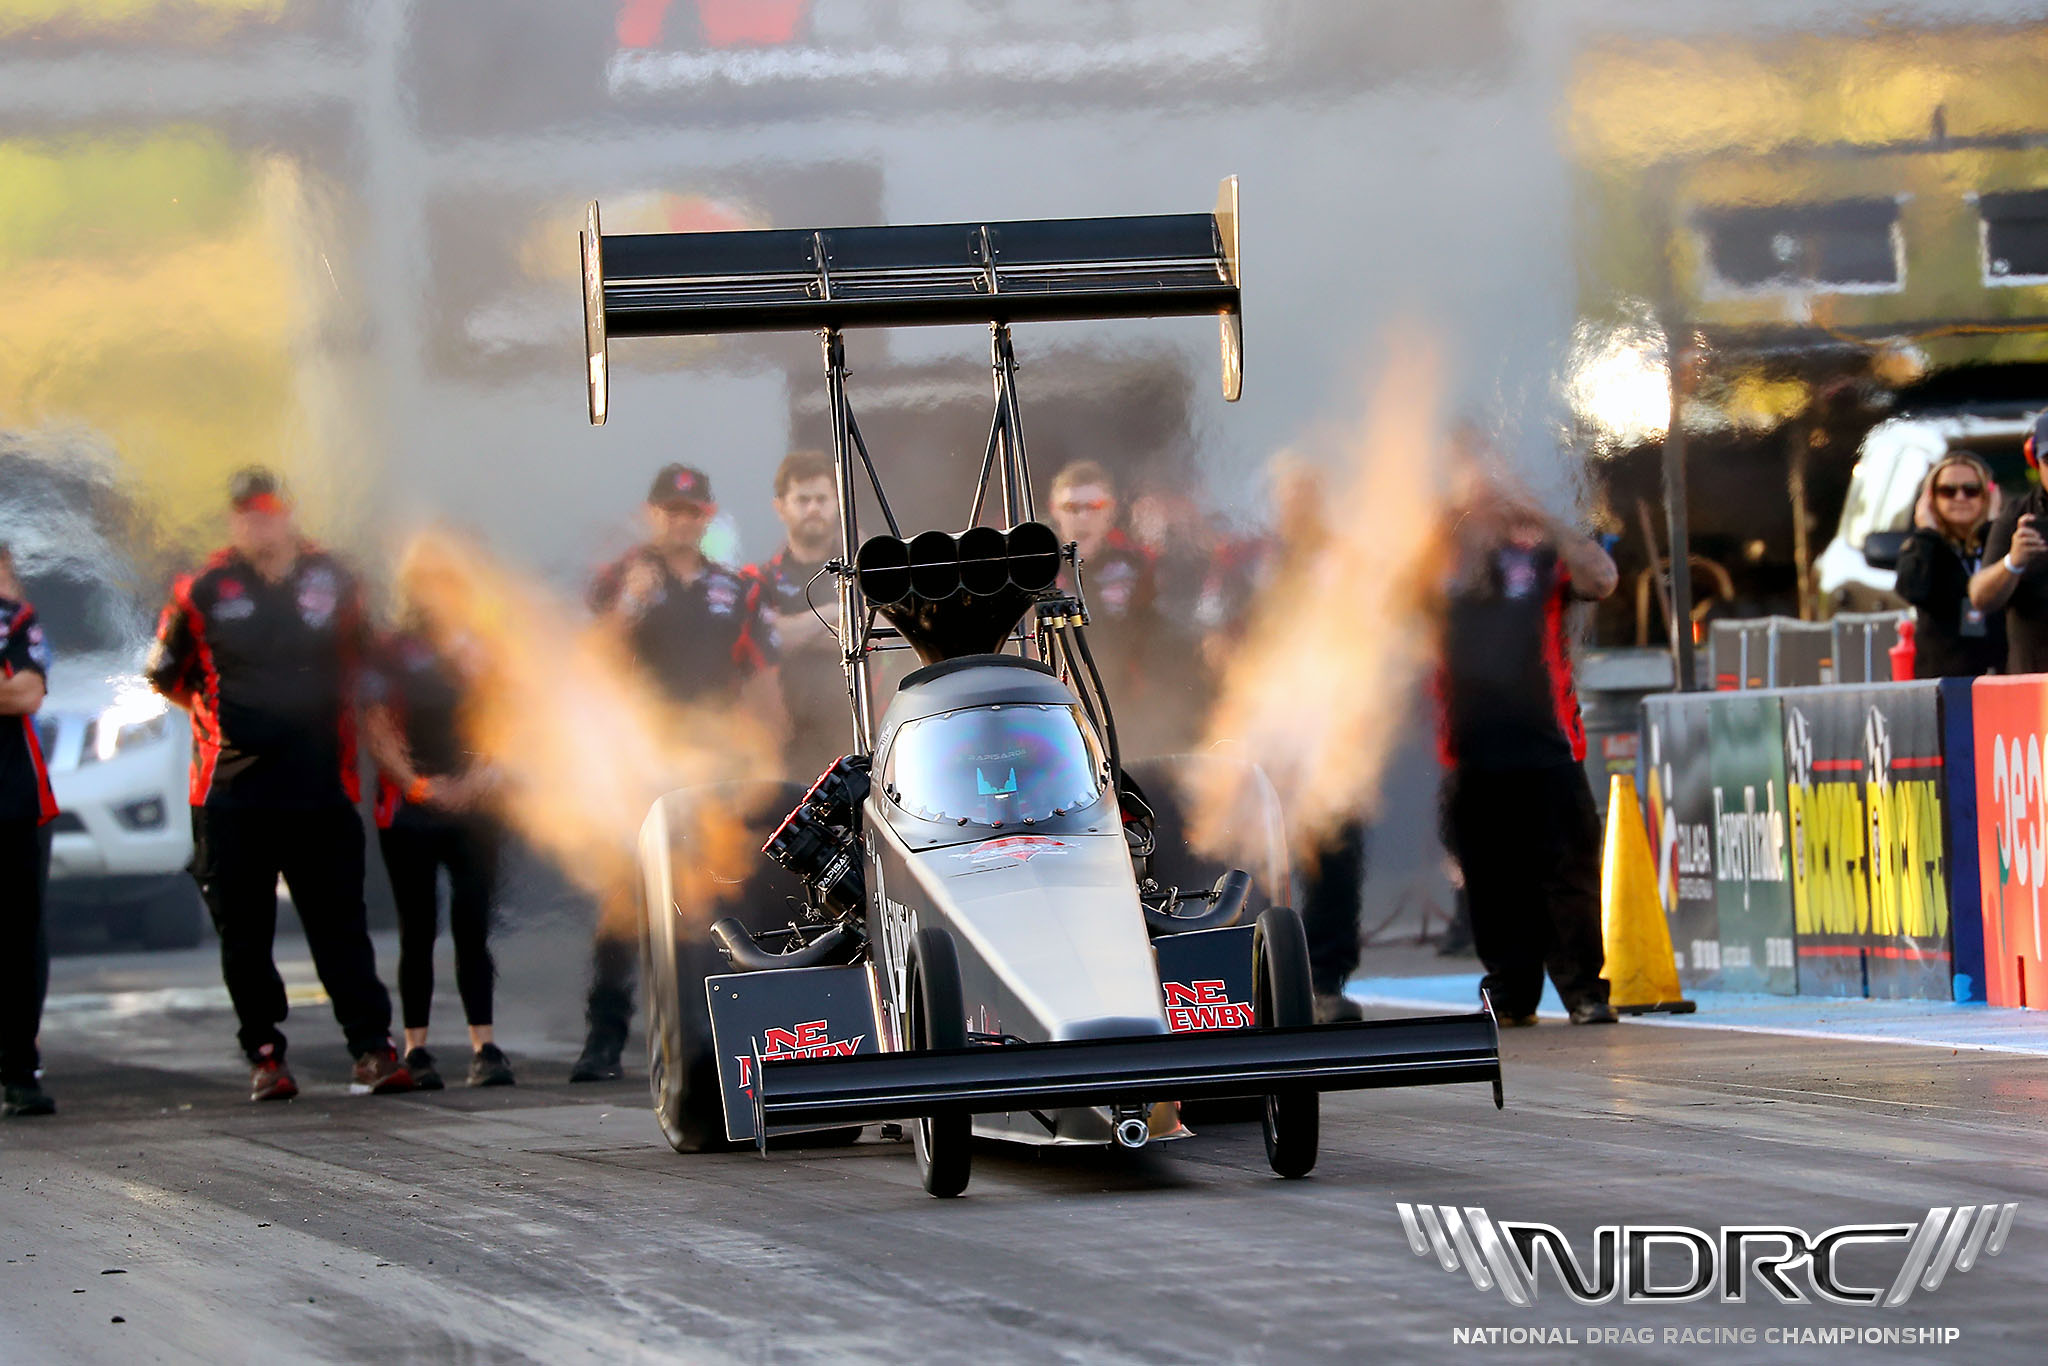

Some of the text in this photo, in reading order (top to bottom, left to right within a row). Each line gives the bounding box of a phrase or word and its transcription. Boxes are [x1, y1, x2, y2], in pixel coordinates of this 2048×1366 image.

[1162, 979, 1229, 1007] NE
[1165, 1002, 1255, 1032] EWBY
[764, 1019, 828, 1055] NE
